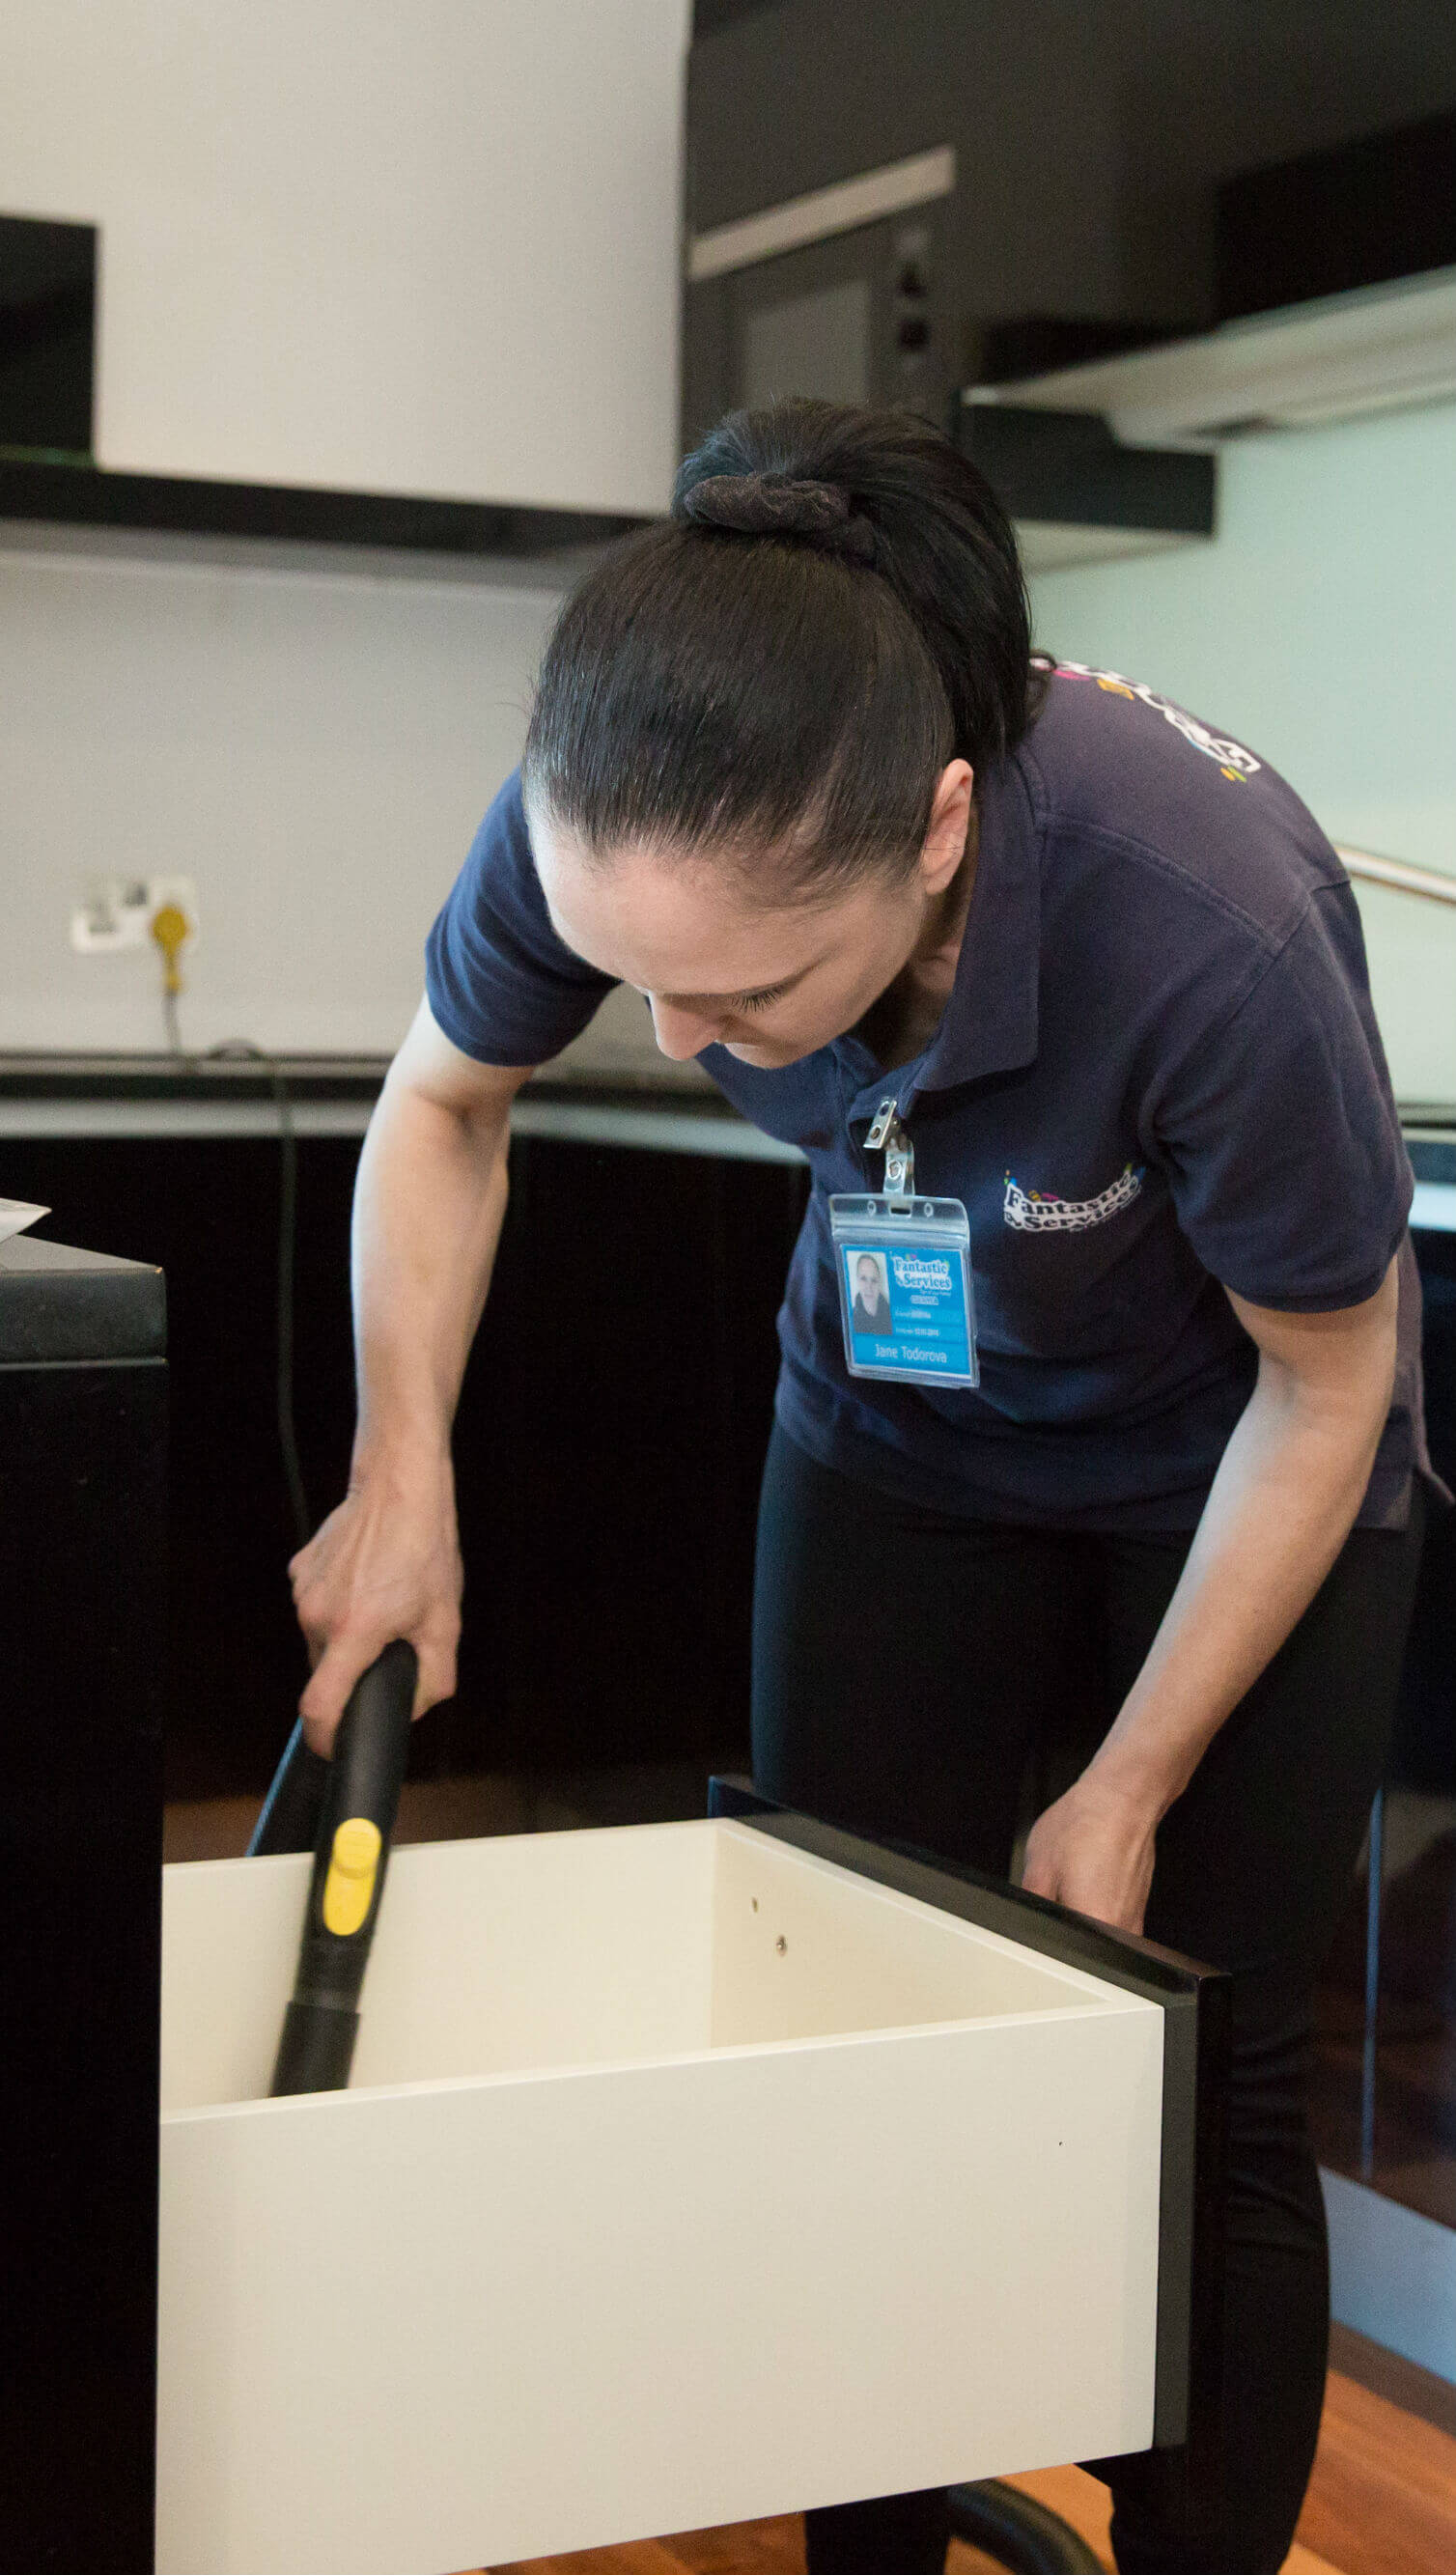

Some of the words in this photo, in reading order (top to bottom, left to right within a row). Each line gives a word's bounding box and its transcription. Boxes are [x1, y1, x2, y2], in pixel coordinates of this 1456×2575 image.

[1005, 1172, 1130, 1216] Fantastic
[1024, 1177, 1139, 1230] Services
[893, 1257, 949, 1274] Fantastic
[904, 1273, 951, 1290] Services
[875, 1343, 898, 1358] Jane
[901, 1346, 947, 1363] Todorova
